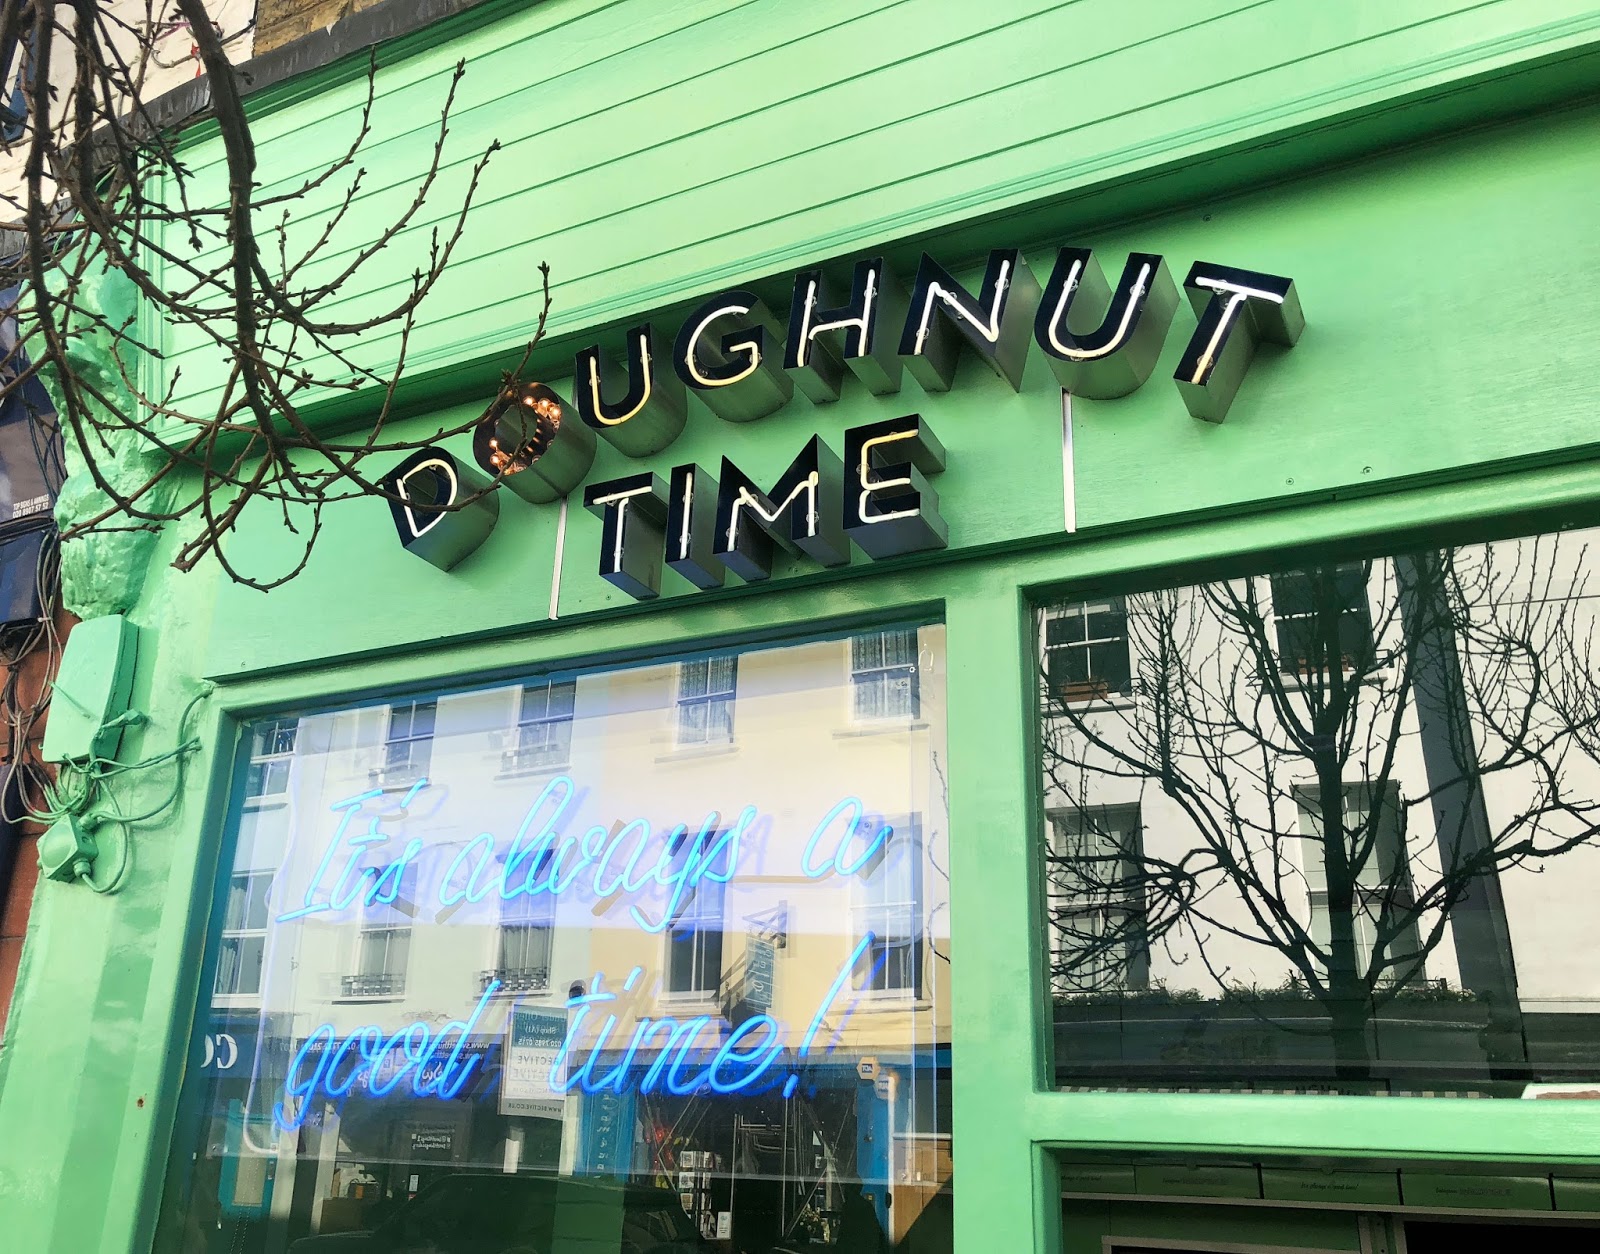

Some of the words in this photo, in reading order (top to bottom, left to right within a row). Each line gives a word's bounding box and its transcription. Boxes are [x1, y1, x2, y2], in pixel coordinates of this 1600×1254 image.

[384, 247, 1301, 558] DOUGHNUT
[13, 510, 22, 518] 020
[584, 414, 936, 595] TIME
[438, 776, 758, 935] always
[799, 796, 894, 879] a
[273, 979, 502, 1133] good
[549, 931, 877, 1101] time!
